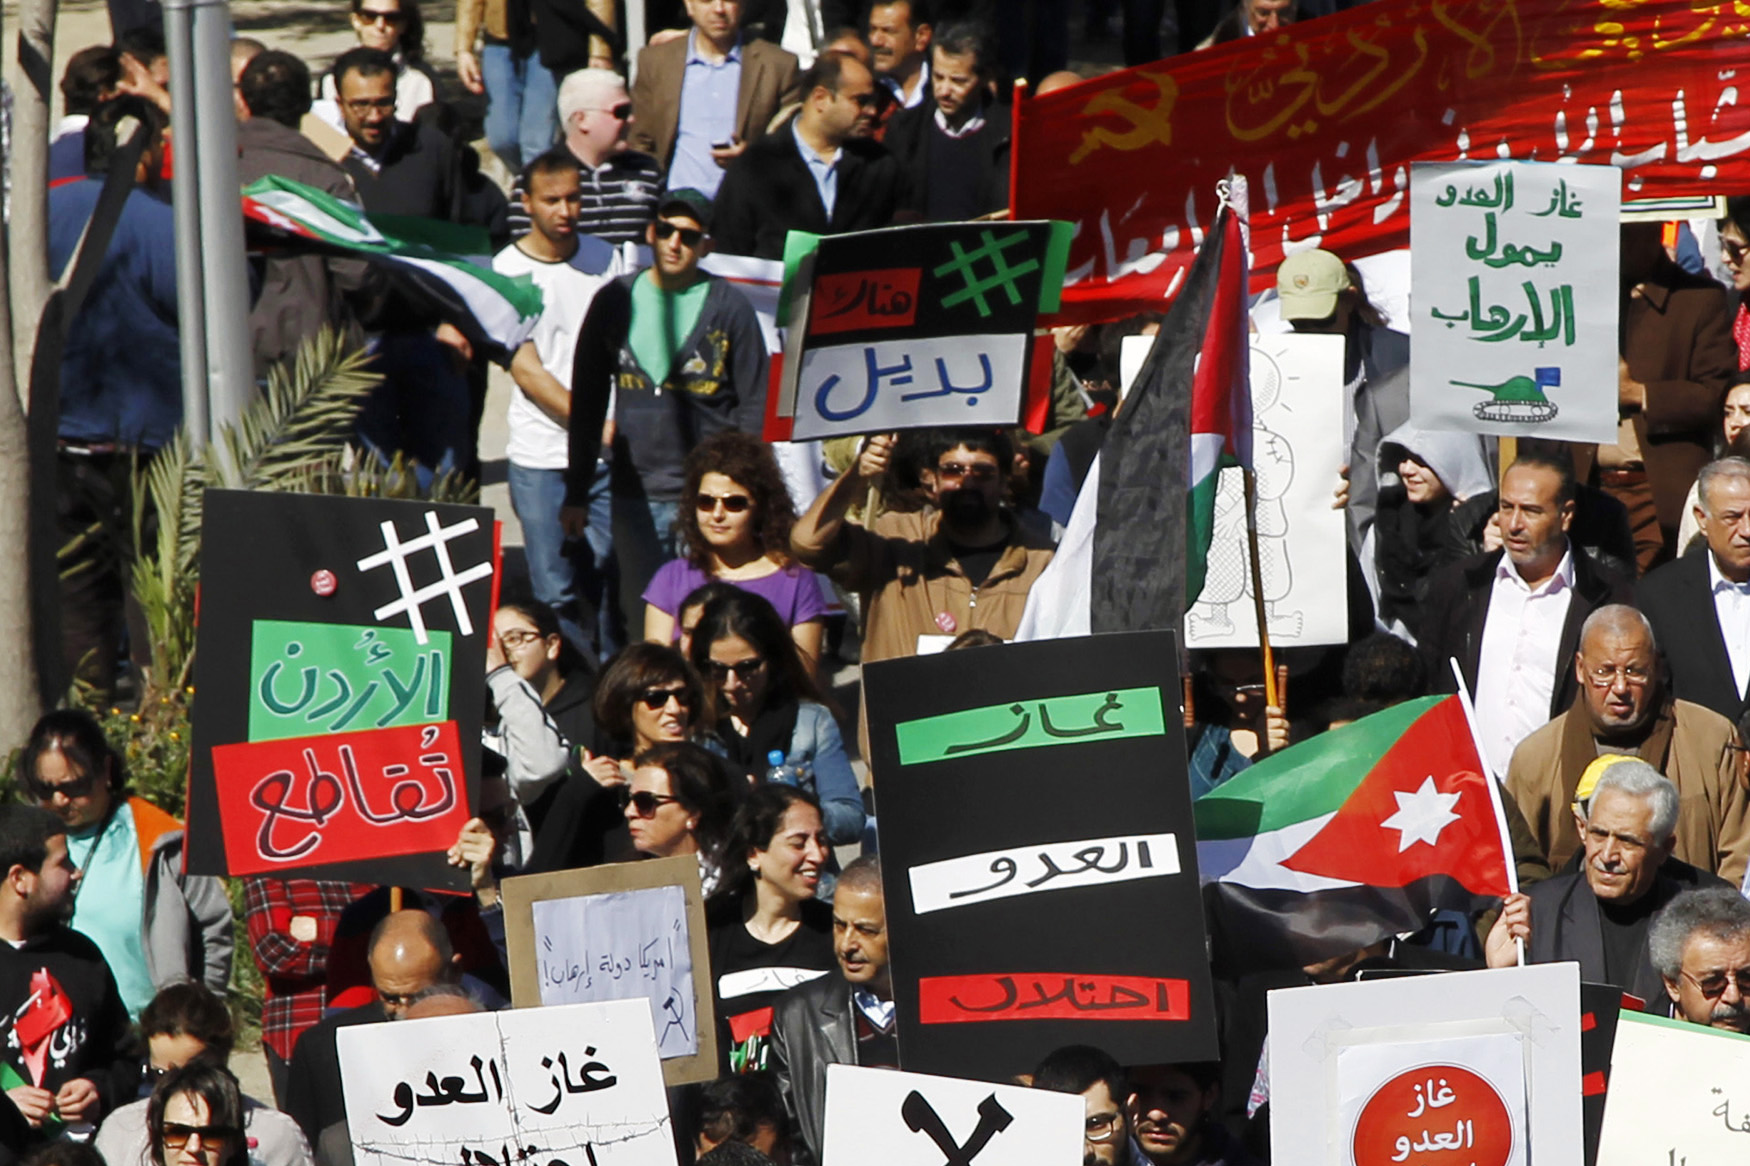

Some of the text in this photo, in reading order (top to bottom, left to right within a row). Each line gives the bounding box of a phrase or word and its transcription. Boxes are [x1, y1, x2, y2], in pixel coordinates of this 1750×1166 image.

[1435, 170, 1583, 219] غاز العدو
[1466, 211, 1563, 268] يمول
[818, 278, 914, 320] هناك
[1431, 275, 1576, 349] الإرهاب
[814, 347, 993, 422] بديل
[943, 692, 1125, 755] غاز
[949, 840, 1154, 900] العدو
[599, 954, 632, 980] دولة
[948, 976, 1170, 1013] احتلال
[376, 1046, 618, 1127] غاز العدو
[1407, 1078, 1457, 1119] غاز
[1391, 1118, 1474, 1162] العدو
